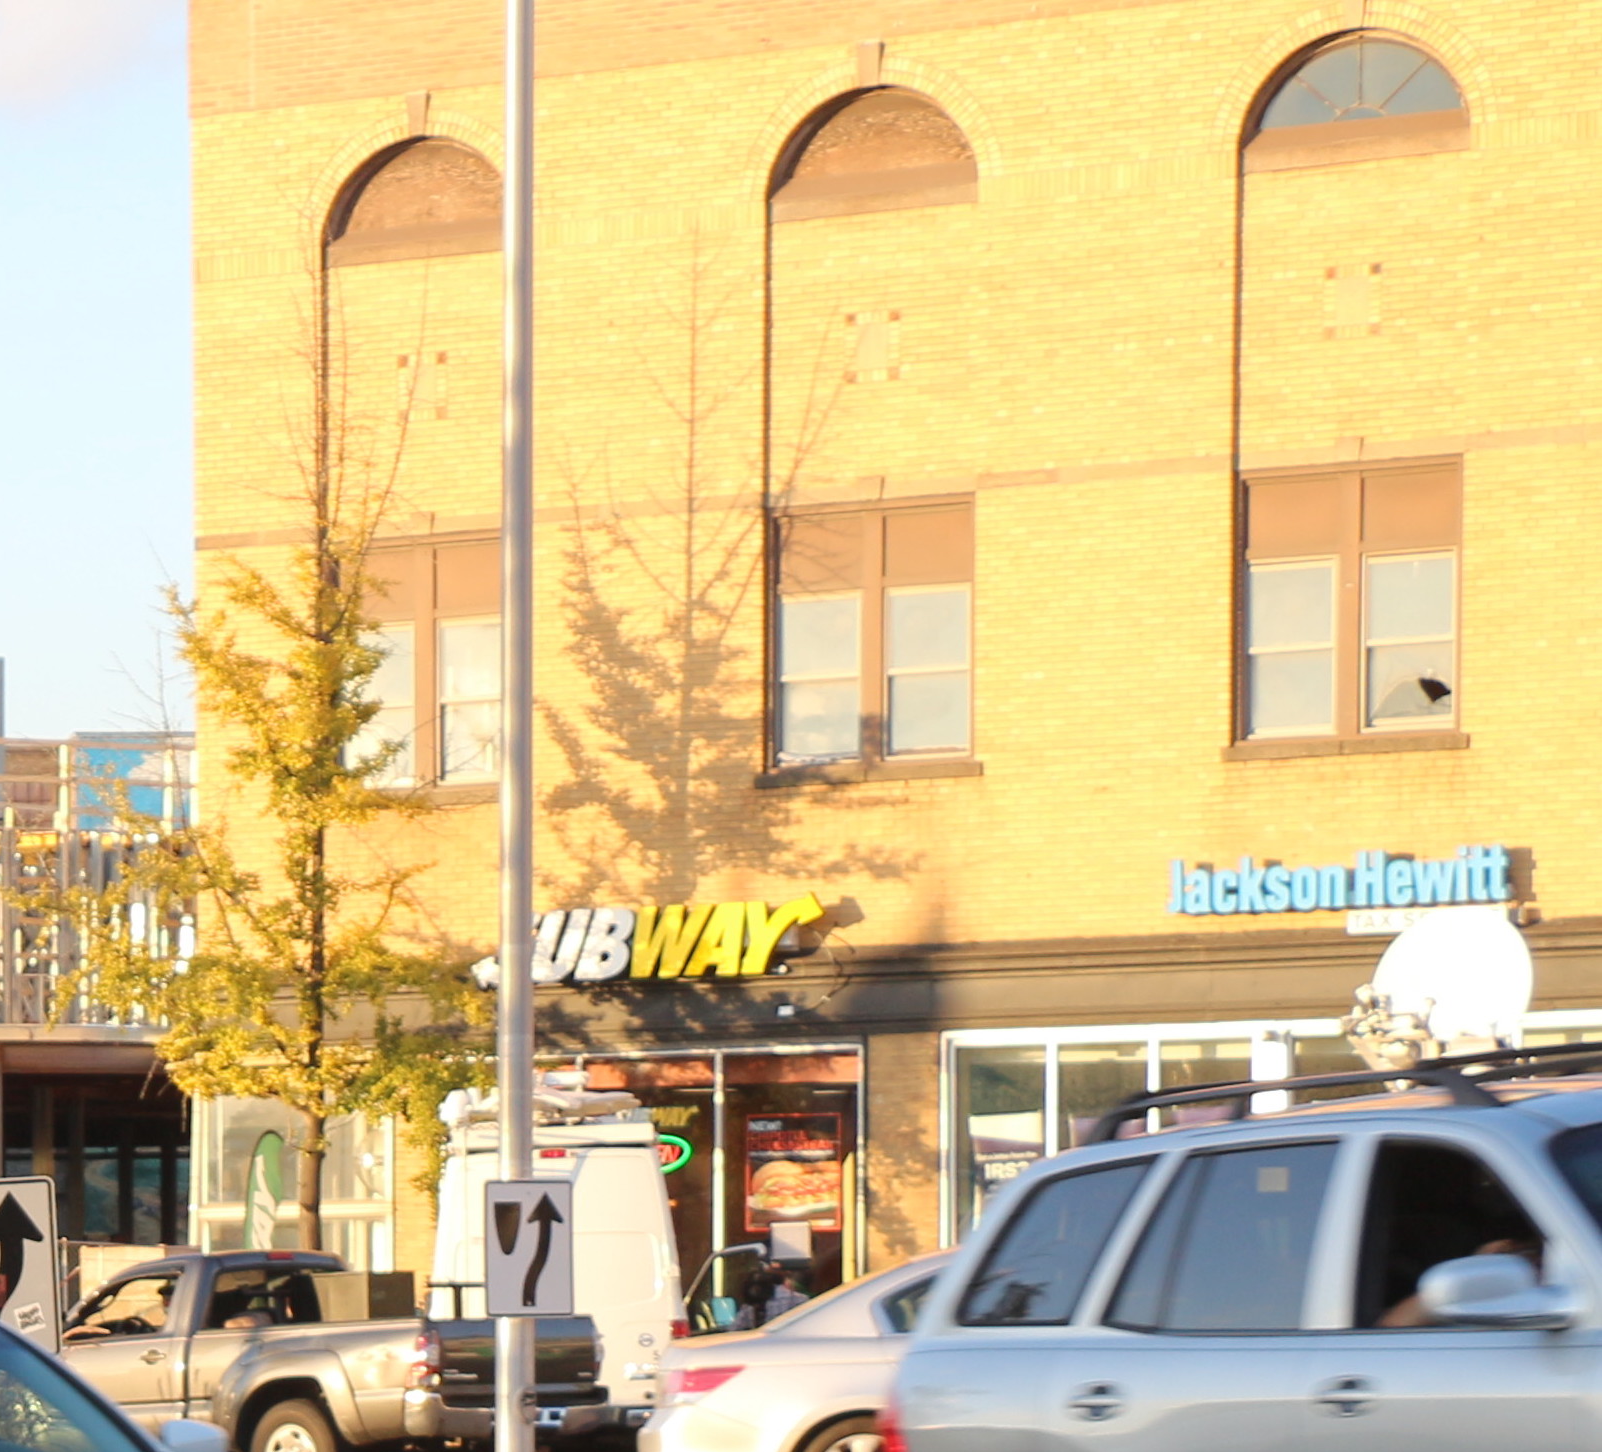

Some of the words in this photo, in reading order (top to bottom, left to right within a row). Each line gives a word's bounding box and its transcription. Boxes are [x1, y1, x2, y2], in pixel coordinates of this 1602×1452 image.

[1169, 836, 1346, 915] Jackson
[1354, 845, 1510, 908] Hewitt
[470, 891, 826, 990] UBWAY
[1353, 914, 1393, 929] TAX
